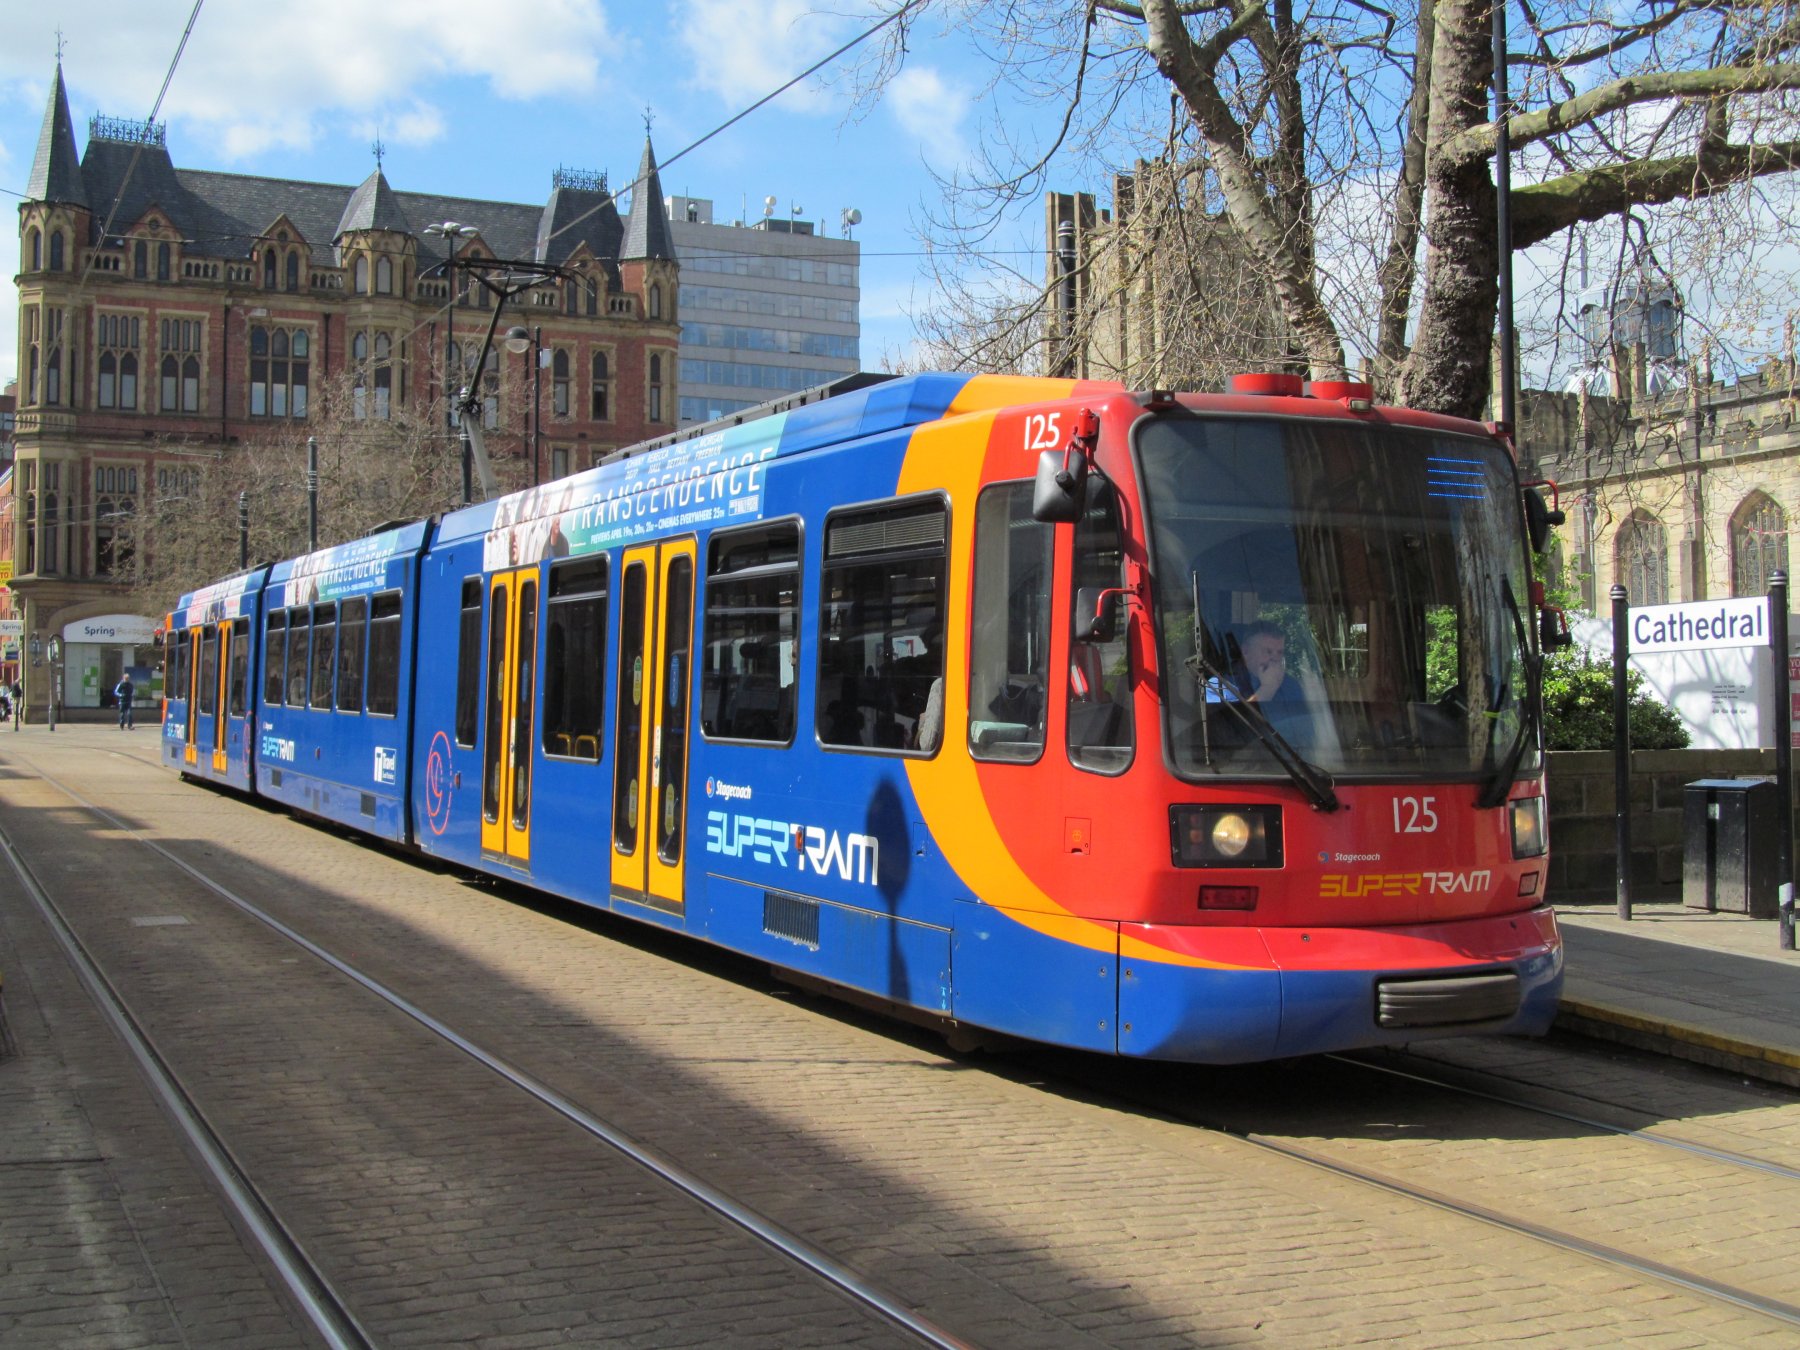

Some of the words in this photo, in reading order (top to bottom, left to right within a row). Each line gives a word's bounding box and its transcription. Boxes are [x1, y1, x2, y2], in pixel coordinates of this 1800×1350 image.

[1024, 412, 1061, 450] 125
[571, 447, 774, 533] TRANSCENDENCE
[658, 514, 679, 529] CINEMAS
[680, 508, 712, 526] EVERYWHERE
[84, 626, 115, 636] Spring
[1634, 605, 1763, 645] Cathedral
[715, 780, 752, 800] Stagecoach
[1392, 796, 1439, 833] 125
[706, 810, 879, 886] SUPERTRAM
[1334, 852, 1381, 864] Stagecoach
[1318, 870, 1491, 897] SUPERTRAM
